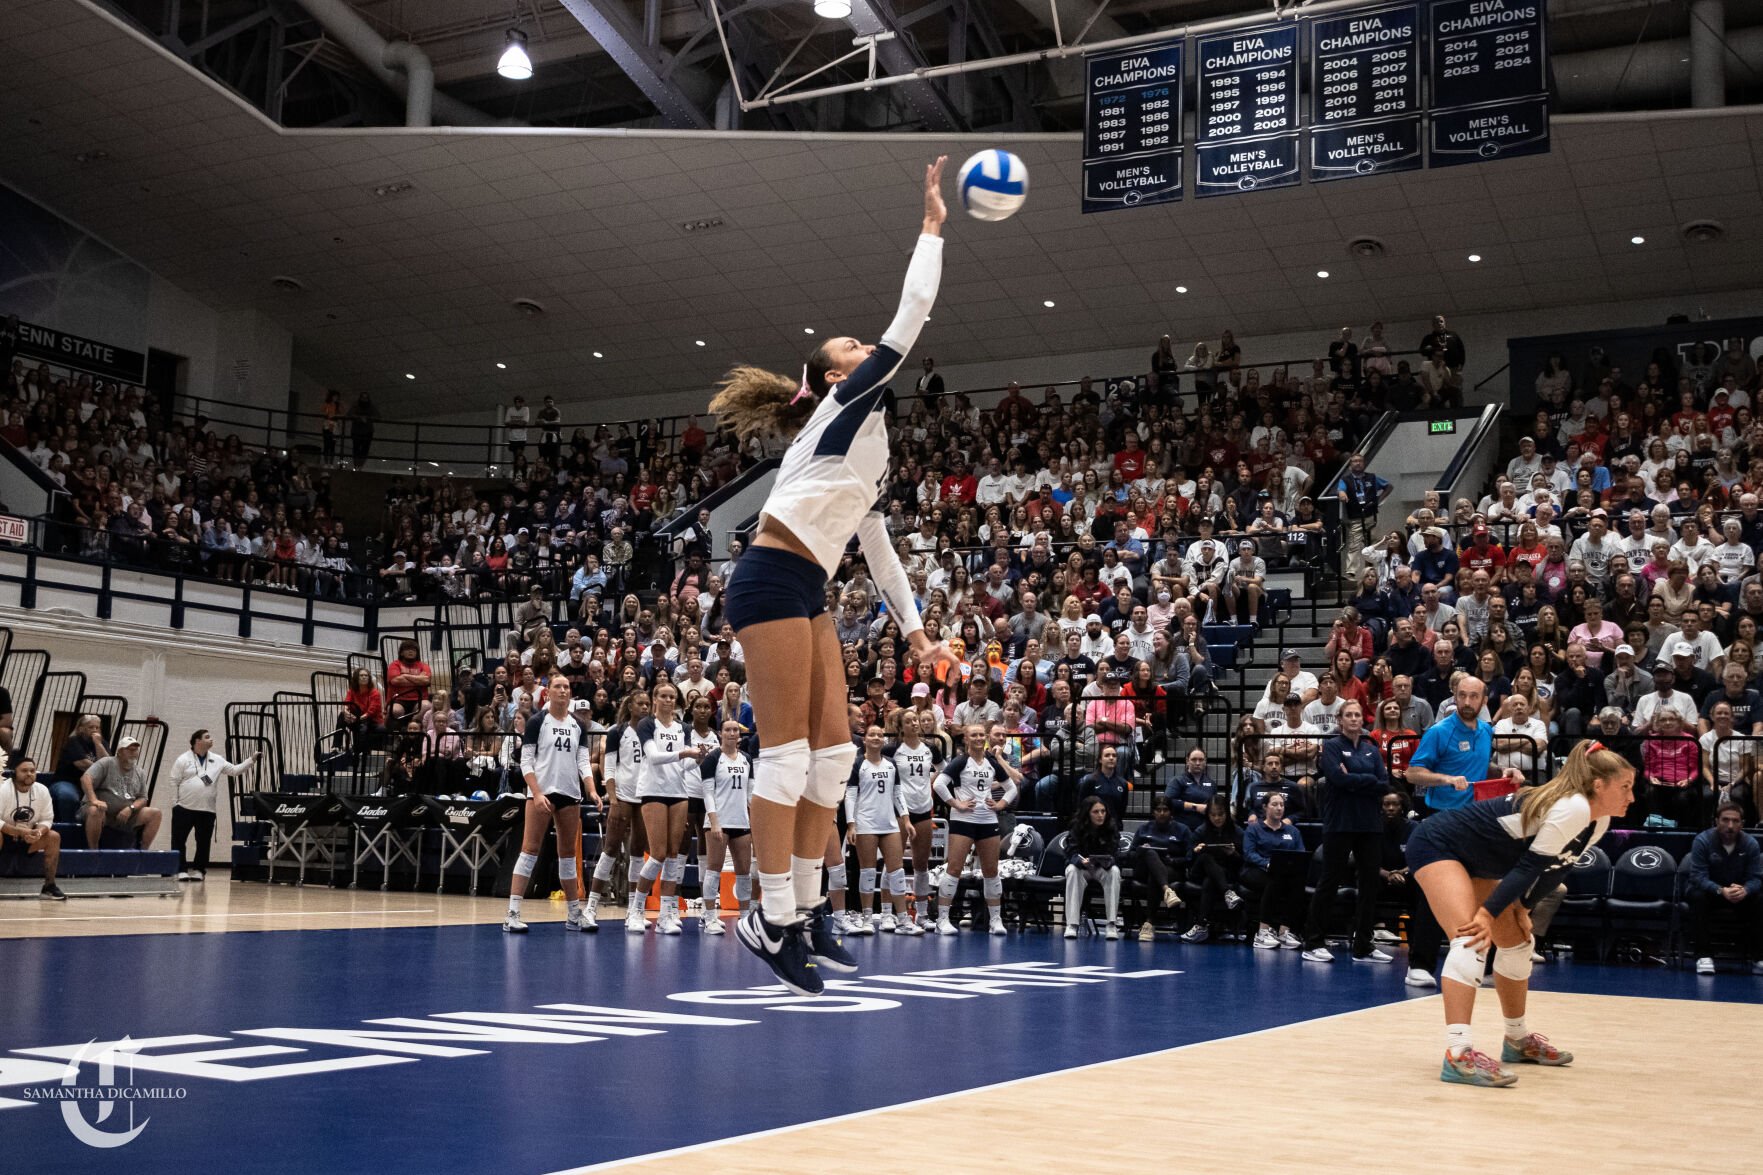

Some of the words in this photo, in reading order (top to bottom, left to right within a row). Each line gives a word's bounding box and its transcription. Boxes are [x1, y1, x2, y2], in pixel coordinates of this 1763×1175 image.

[1470, 0, 1504, 14] EIVA
[1350, 18, 1382, 32] EIVA
[1439, 7, 1536, 32] CHAMPIONS
[1234, 38, 1264, 52] EIVA
[1320, 26, 1412, 50] CHAMPIONS
[1444, 40, 1478, 52] 2014
[1496, 31, 1529, 44] 2015
[1206, 46, 1291, 69] CHAMPIONS
[1324, 58, 1358, 70] 2004
[1372, 50, 1407, 62] 2005
[1445, 52, 1478, 64] 2017
[1496, 44, 1529, 56] 2021
[1121, 57, 1150, 71] EIVA
[1324, 70, 1358, 82] 2006
[1372, 62, 1407, 74] 2007
[1444, 65, 1480, 78] 2023
[1495, 56, 1532, 70] 2024
[1095, 65, 1176, 87] CHAMPIONS
[1210, 76, 1240, 87] 1993
[1256, 70, 1286, 80] 1994
[1210, 89, 1240, 100] 1995
[1256, 82, 1285, 93] 1996
[1324, 83, 1358, 94] 2008
[1372, 75, 1407, 87] 2009
[1141, 88, 1169, 98] 1976
[1325, 96, 1357, 107] 2010
[1375, 88, 1404, 100] 2011
[1100, 107, 1124, 117] 1981
[1141, 100, 1169, 111] 1982
[1211, 101, 1240, 112] 1997
[1256, 94, 1285, 105] 1999
[1325, 108, 1356, 120] 2012
[1374, 101, 1406, 112] 2013
[1098, 118, 1126, 129] 1983
[1140, 112, 1169, 123] 1986
[1209, 113, 1241, 124] 2000
[1255, 106, 1285, 118] 2001
[1469, 115, 1509, 128] MEN'S
[1098, 130, 1126, 140] 1987
[1140, 124, 1169, 135] 1989
[1209, 125, 1241, 137] 2002
[1254, 118, 1286, 130] 2003
[1449, 124, 1529, 142] VOLLEYBALL
[1099, 143, 1124, 152] 1991
[1140, 136, 1168, 147] 1992
[1347, 133, 1384, 146] MEN'S
[1230, 150, 1266, 162] MEN'S
[1328, 142, 1404, 159] VOLLEYBALL
[1117, 167, 1150, 178] MEN'S
[1213, 158, 1283, 176] VOLLEYBALL
[1099, 175, 1166, 191] VOLLEYBALL
[17, 324, 56, 349] ENN
[61, 336, 115, 364] STATE
[1431, 422, 1454, 432] EXIT
[10, 522, 24, 537] AID
[1287, 532, 1305, 542] 112
[554, 737, 571, 752] 44
[666, 742, 673, 752] 4
[909, 763, 923, 776] 14
[732, 775, 742, 789] 11
[878, 780, 885, 793] 9
[977, 779, 984, 791] 6
[275, 804, 306, 814] Baden
[357, 806, 388, 816] Baden
[445, 806, 476, 817] Baden
[666, 961, 1185, 1012] STATE
